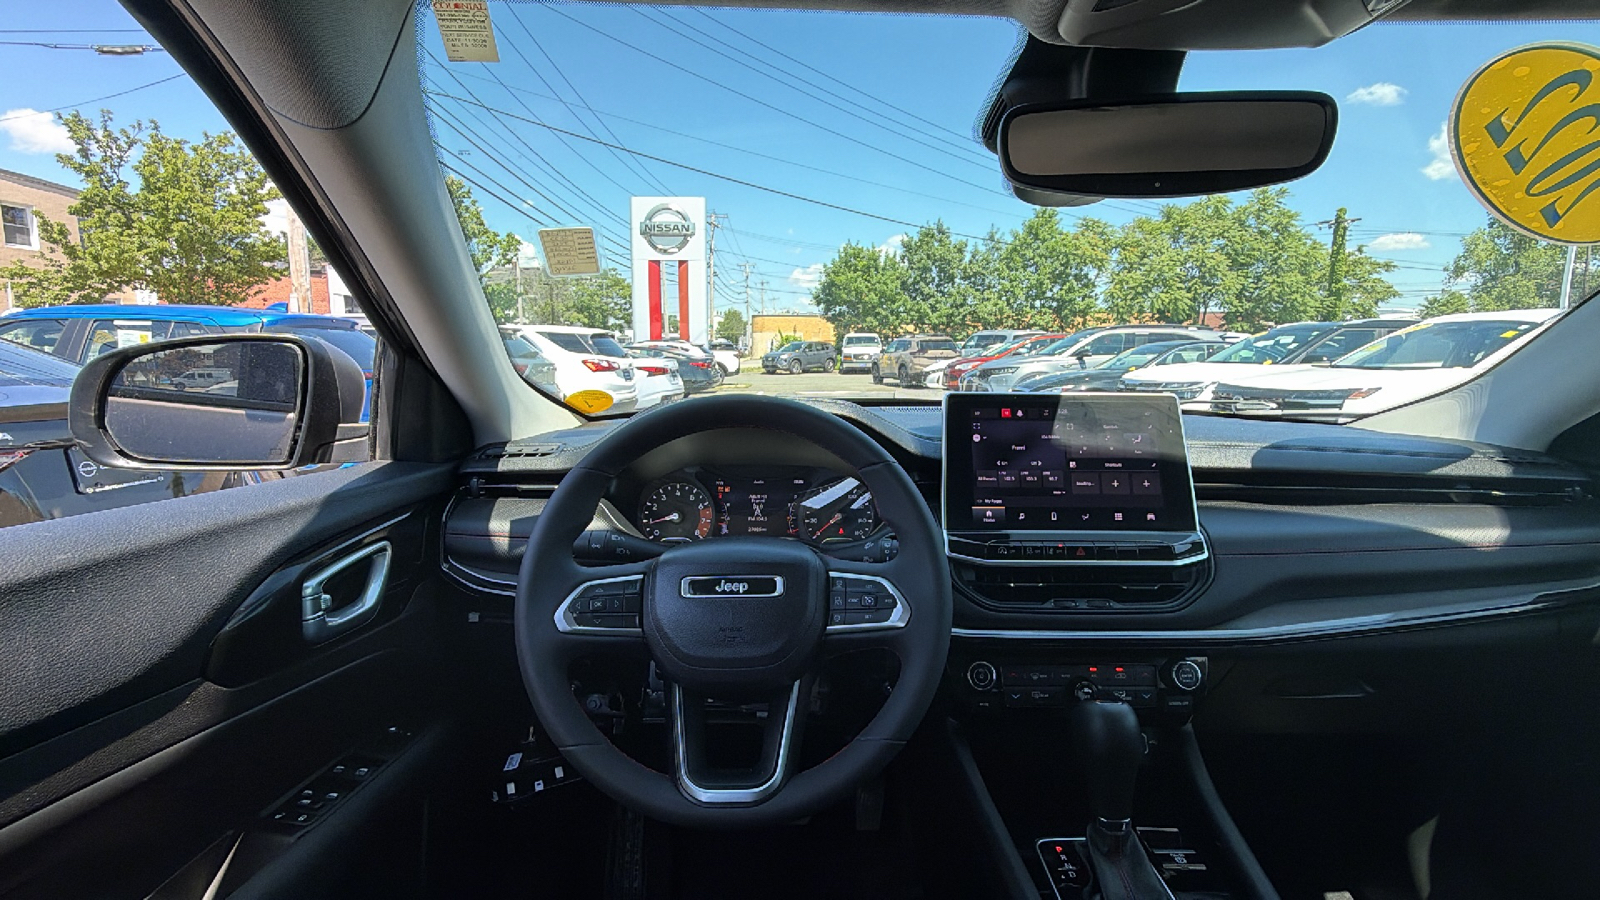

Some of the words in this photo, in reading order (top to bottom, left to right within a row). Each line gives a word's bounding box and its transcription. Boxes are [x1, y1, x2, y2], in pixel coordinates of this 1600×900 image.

[644, 223, 690, 233] NISSAN
[715, 579, 749, 593] Jeep
[1055, 845, 1063, 853] P
